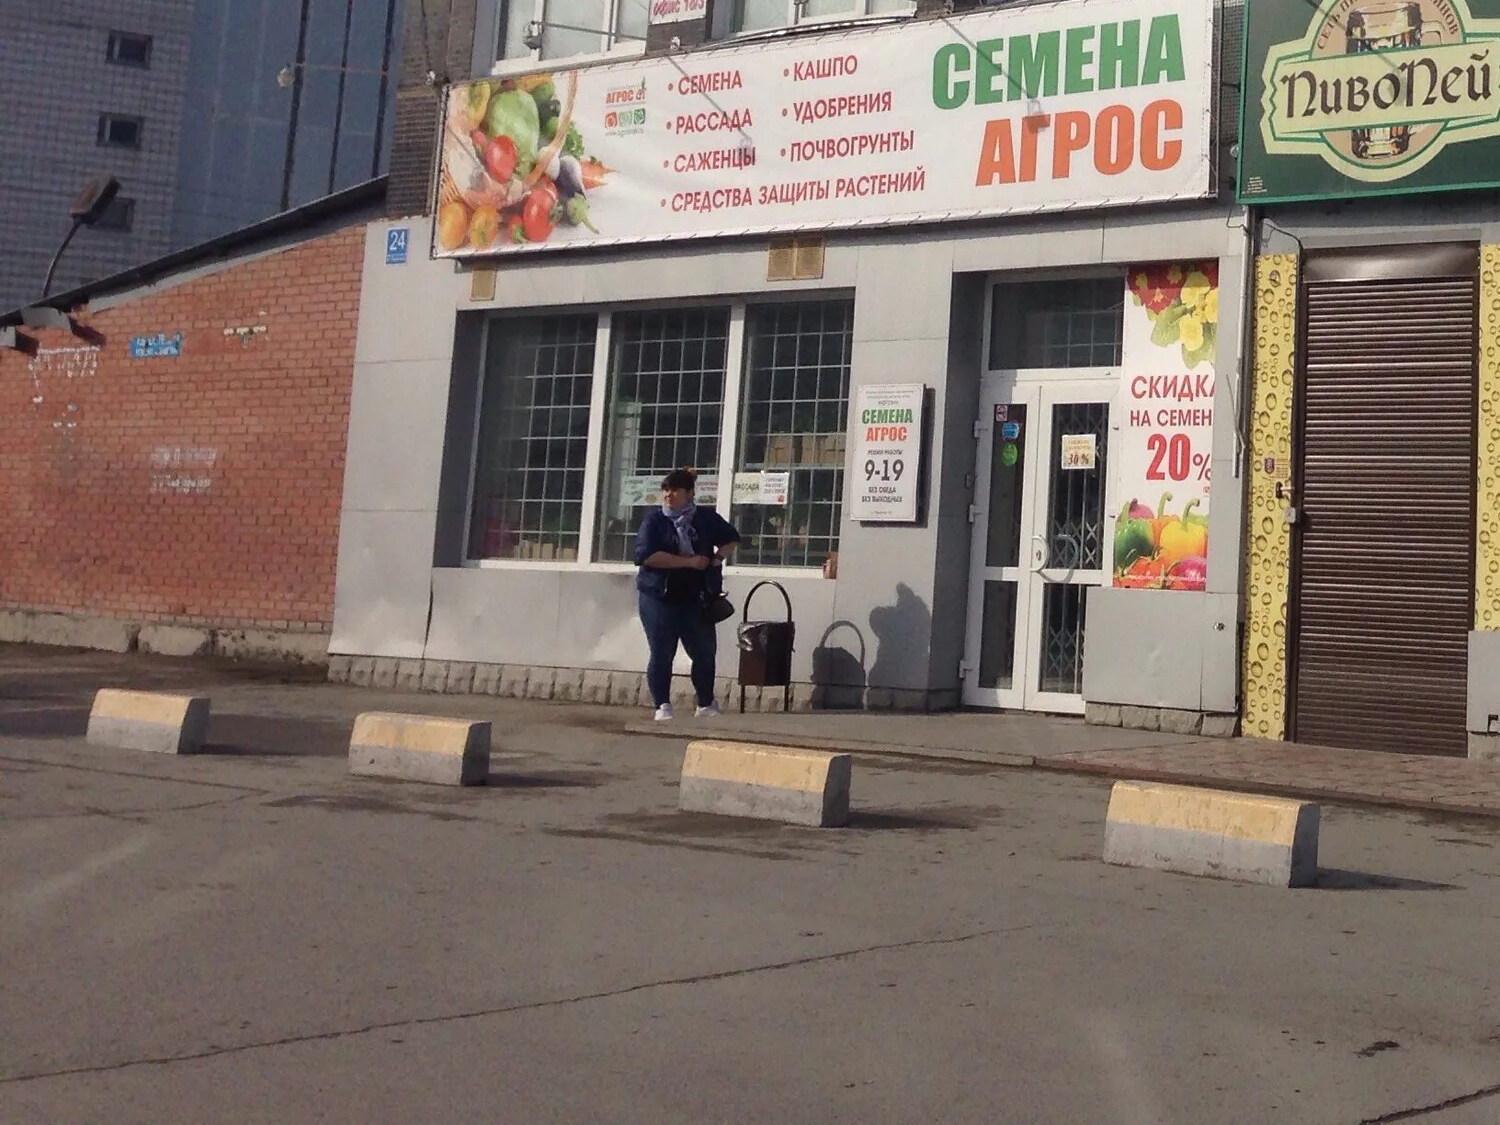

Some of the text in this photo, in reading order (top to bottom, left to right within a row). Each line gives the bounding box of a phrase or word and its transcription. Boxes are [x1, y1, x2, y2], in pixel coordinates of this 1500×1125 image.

[1316, 11, 1342, 51] СЕТЬ
[677, 70, 743, 95] СЕМЕНА
[793, 55, 858, 82] КАШПО
[930, 13, 1186, 111] СЕМЕНА
[675, 91, 893, 134] РАССАДА УДОБРЕНИЯ
[673, 130, 915, 173] САЖЕНЦЫ ПОЧВОГРУНТЫ
[975, 99, 1184, 187] АГРОС
[671, 165, 926, 213] СРЕДСТВА ЗАЩИТЫ РАСТЕНИЙ
[389, 231, 406, 252] 24
[1130, 375, 1216, 401] СКИДК
[862, 408, 913, 424] СЕМЕНА
[865, 425, 907, 441] АГРОС
[1129, 409, 1153, 427] НА
[864, 459, 905, 481] 9-19
[1145, 432, 1213, 481] 20%
